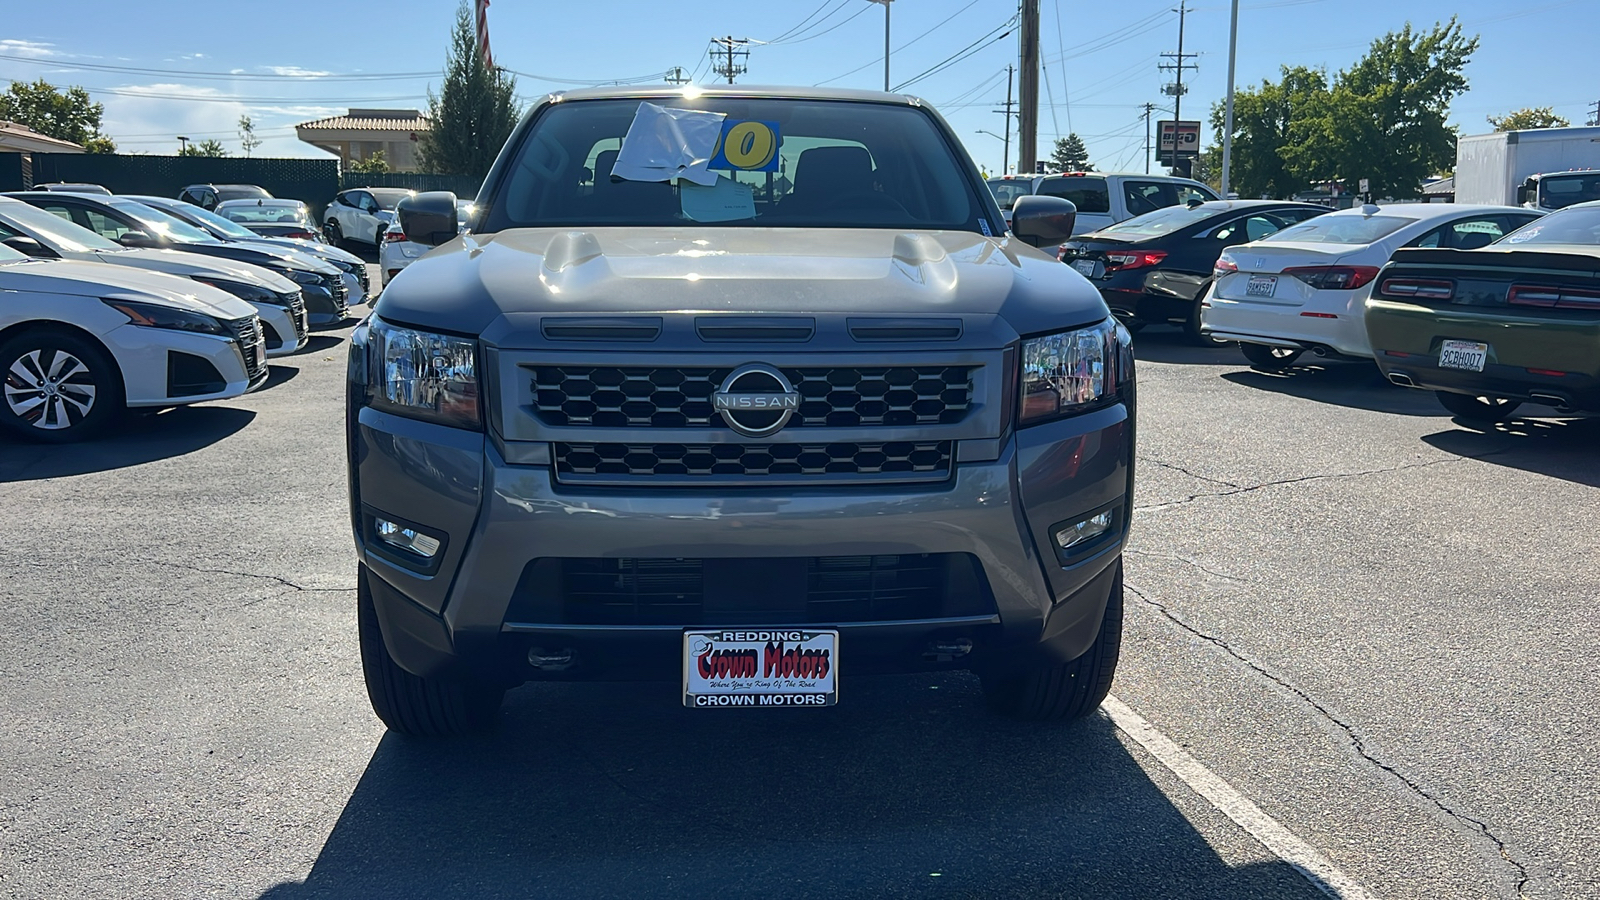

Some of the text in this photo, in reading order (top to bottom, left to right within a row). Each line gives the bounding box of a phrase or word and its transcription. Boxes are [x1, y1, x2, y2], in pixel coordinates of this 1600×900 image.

[1442, 350, 1482, 367] 9CBH007
[717, 396, 796, 407] NISSAN
[722, 631, 802, 642] REDDING
[697, 642, 830, 680] Crown Motors
[709, 680, 816, 691] Where You're King Of The Road
[696, 694, 826, 706] CROWN MOTORS
